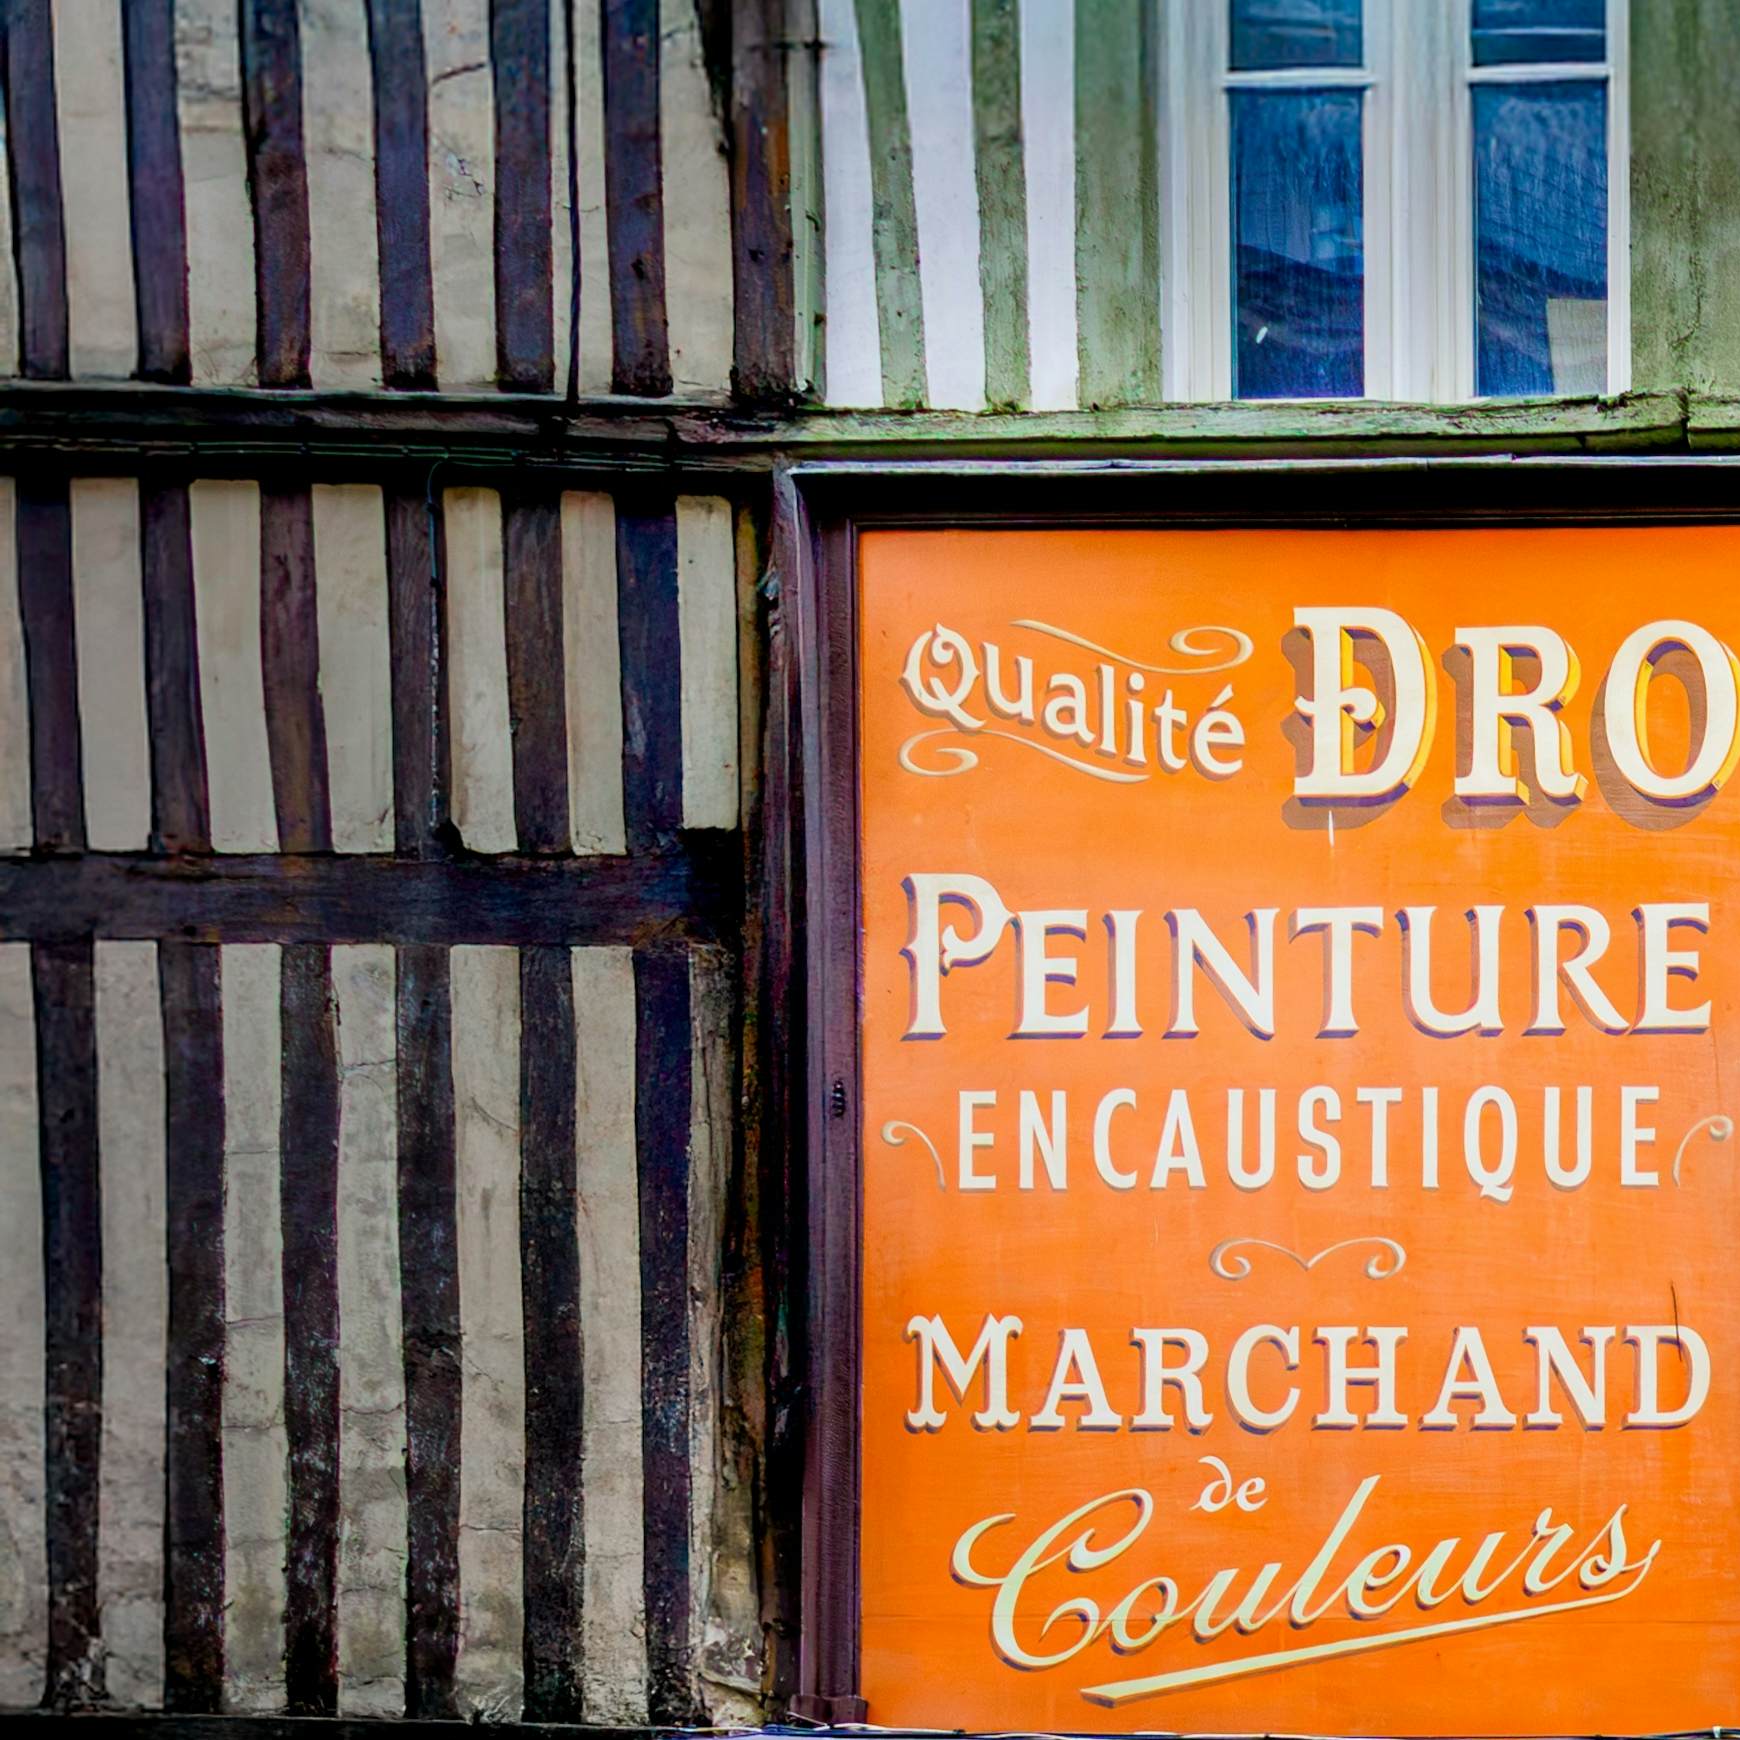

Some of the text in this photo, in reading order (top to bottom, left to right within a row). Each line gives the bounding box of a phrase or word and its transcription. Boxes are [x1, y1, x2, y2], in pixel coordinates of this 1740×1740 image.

[900, 622, 1248, 779] Qualité
[899, 873, 1713, 1041] PEINTURE
[956, 1085, 1661, 1202] ENCAUSTIQUE
[904, 1314, 1712, 1435] MARCHAND
[1189, 1456, 1268, 1513] de
[951, 1474, 1663, 1673] Couleurs
